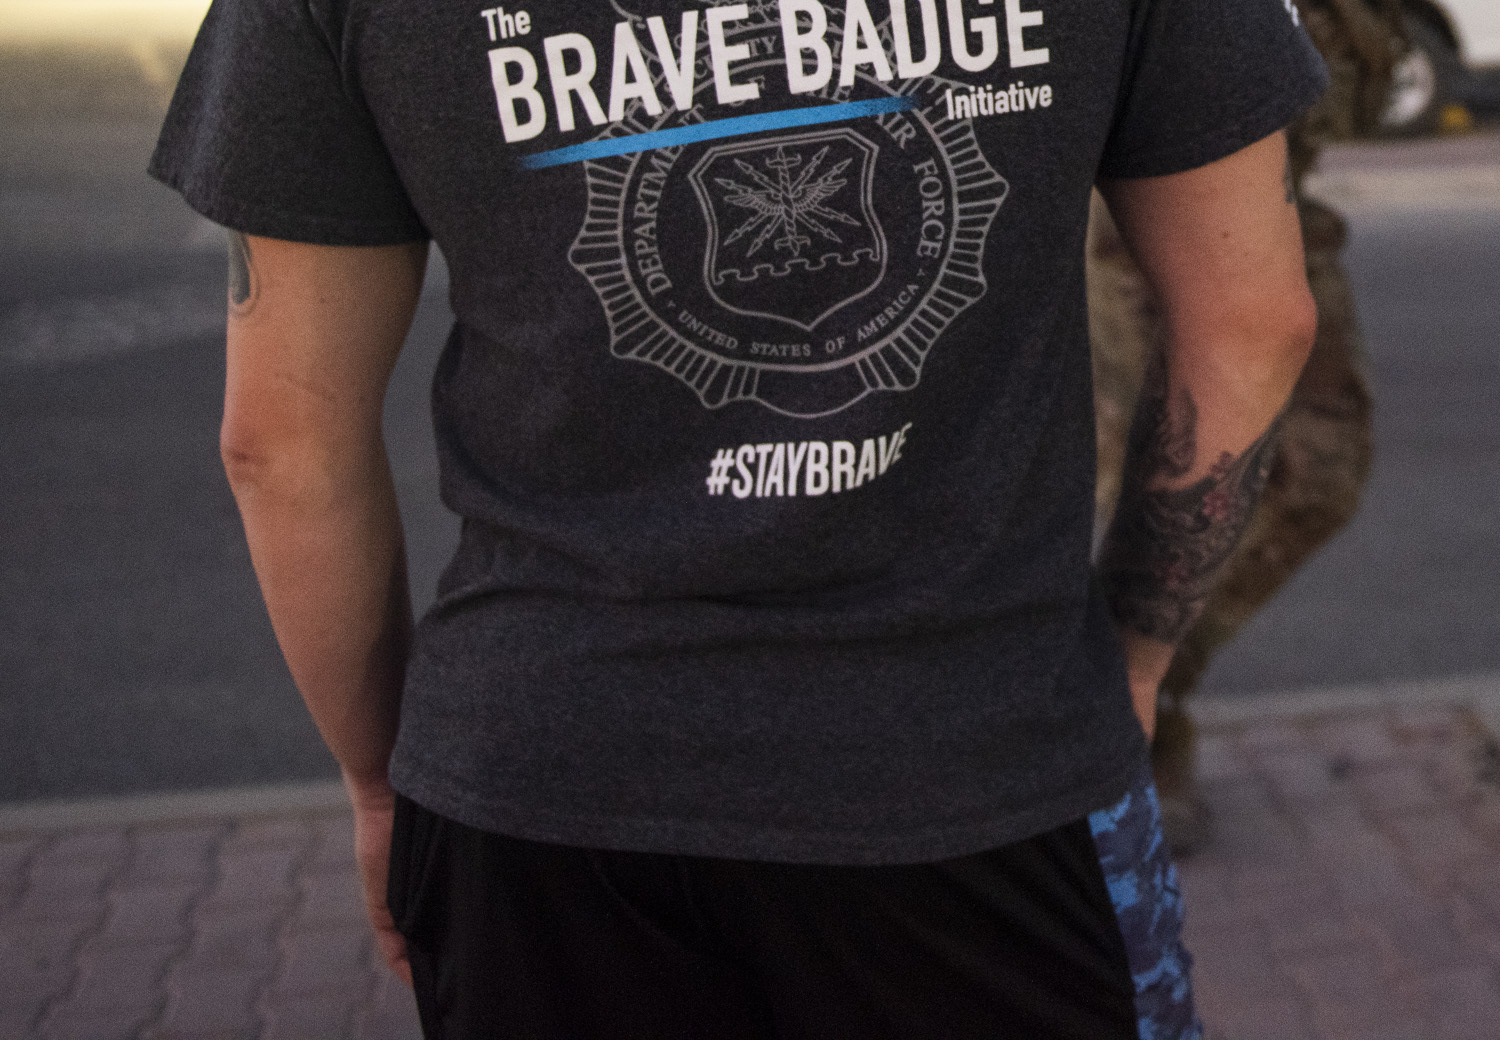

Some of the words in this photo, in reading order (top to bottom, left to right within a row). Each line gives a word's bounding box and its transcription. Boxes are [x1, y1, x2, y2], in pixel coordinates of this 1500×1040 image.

[481, 6, 531, 44] The
[488, 4, 760, 144] BRAVE
[945, 81, 1053, 121] Initiative
[912, 156, 946, 259] FORCE
[678, 310, 738, 350] UNITED
[750, 341, 811, 357] STATES
[825, 335, 847, 353] OF
[855, 283, 920, 342] AMERICA
